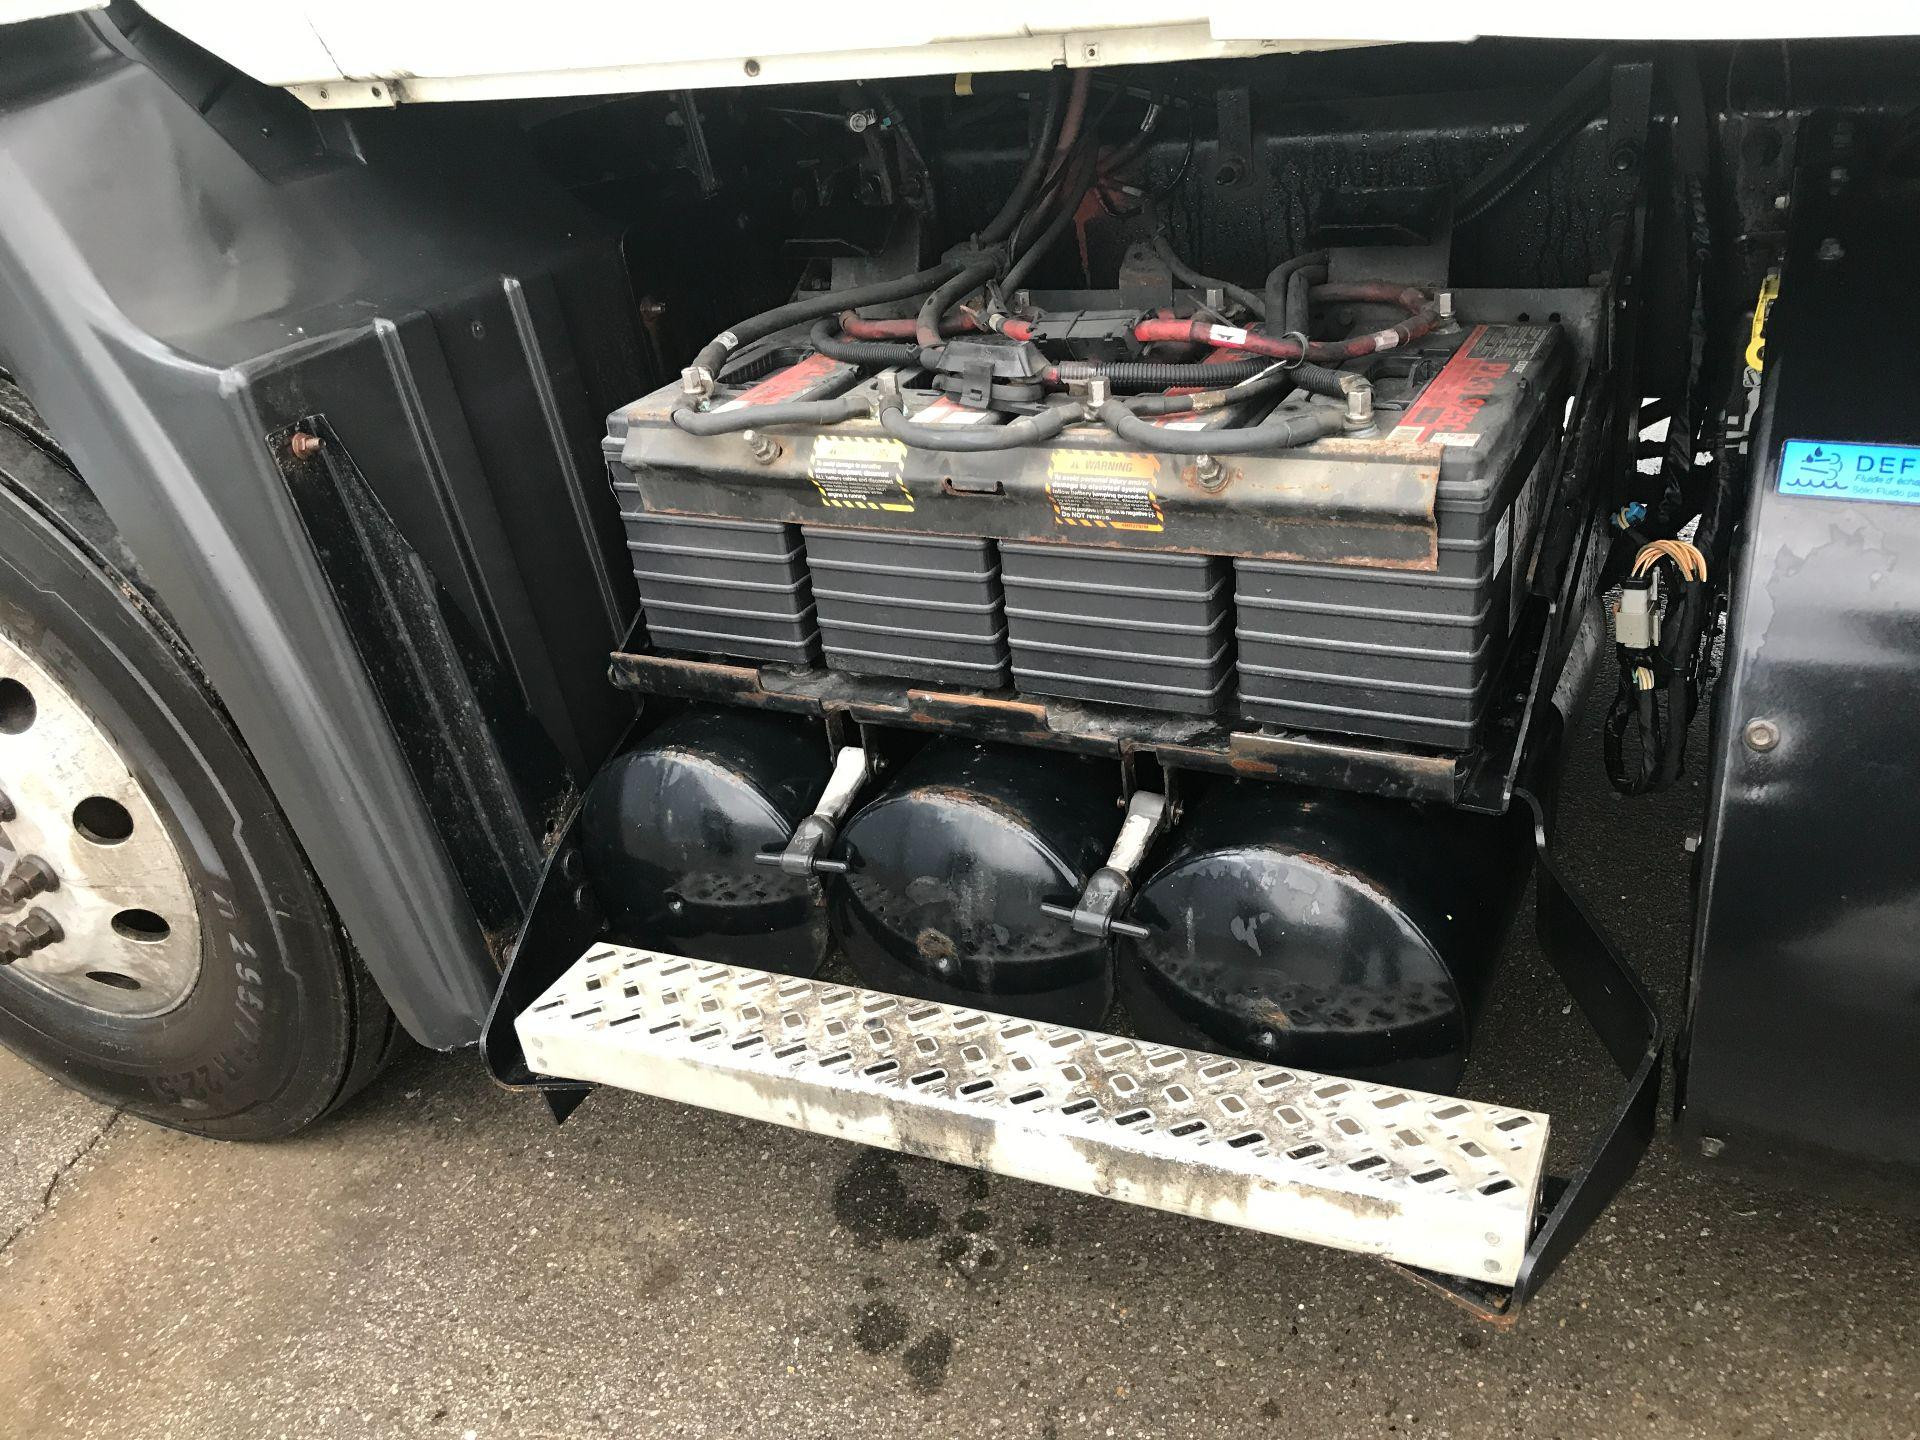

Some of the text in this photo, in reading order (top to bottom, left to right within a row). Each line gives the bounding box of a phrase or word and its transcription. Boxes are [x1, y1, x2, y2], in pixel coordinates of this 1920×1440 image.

[1085, 459, 1133, 473] WARNING
[1856, 455, 1917, 474] DEF
[1051, 482, 1079, 490] damage
[1080, 476, 1108, 484] personal
[1109, 477, 1128, 486] injury
[1070, 490, 1092, 498] battery
[1092, 491, 1117, 499] jumping
[1876, 487, 1905, 497] Fluido
